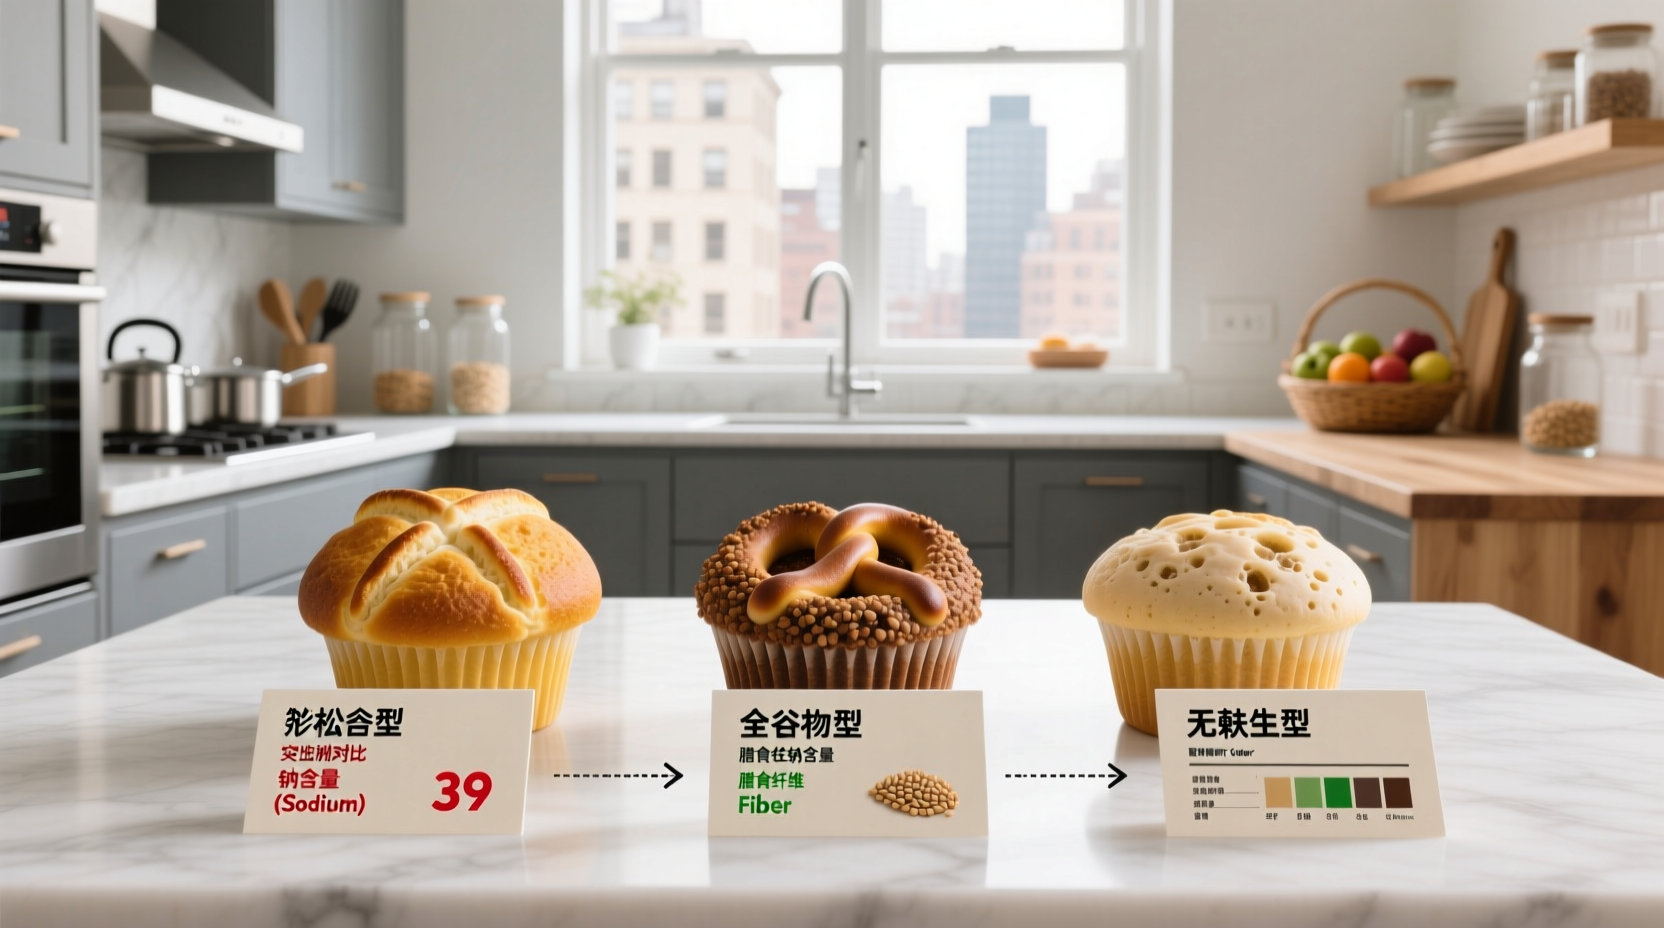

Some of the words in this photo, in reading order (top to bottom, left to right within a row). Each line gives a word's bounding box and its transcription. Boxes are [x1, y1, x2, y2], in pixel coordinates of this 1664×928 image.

[740, 708, 862, 739] 全谷物型
[278, 767, 340, 789] 钠含量
[431, 771, 493, 811] 39
[274, 793, 366, 816] (Sodium)
[738, 794, 792, 814] Fiber
